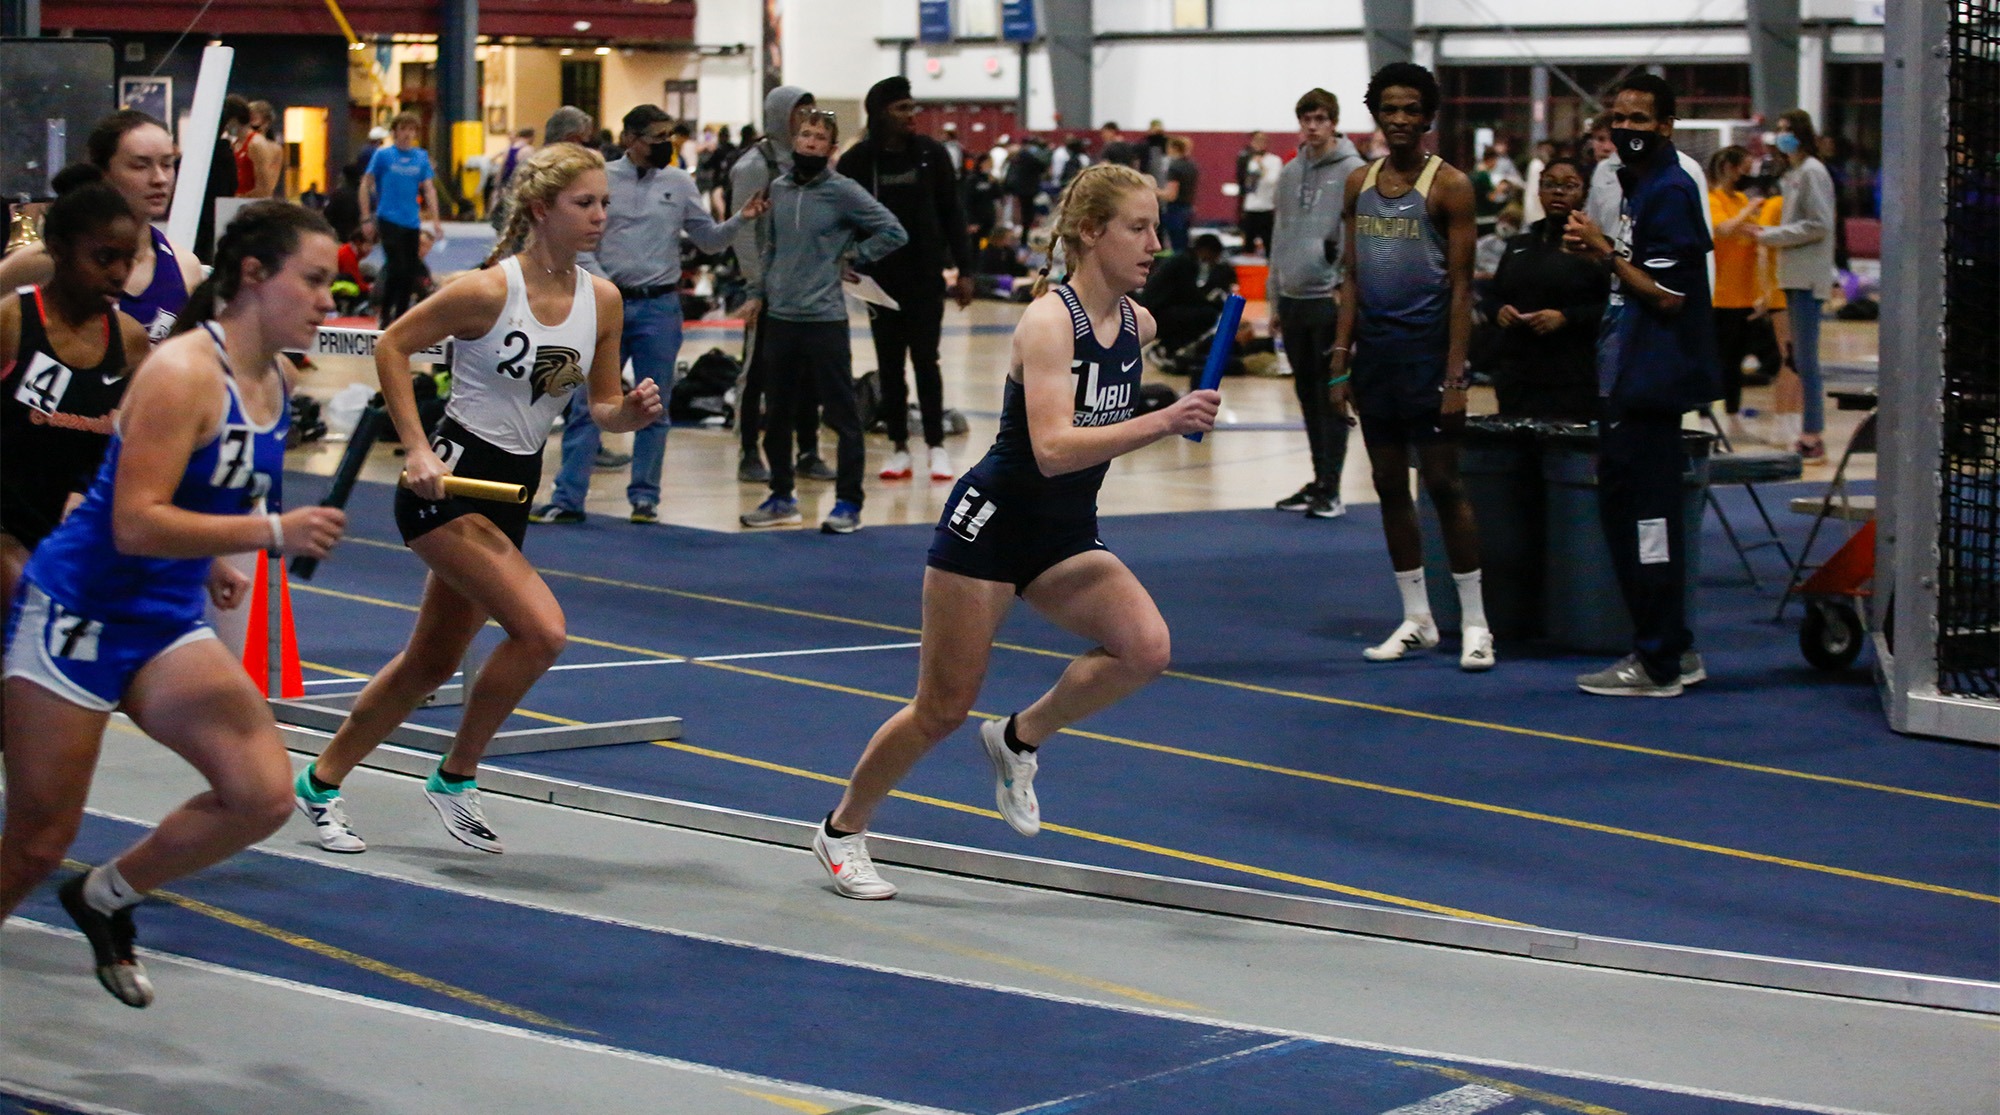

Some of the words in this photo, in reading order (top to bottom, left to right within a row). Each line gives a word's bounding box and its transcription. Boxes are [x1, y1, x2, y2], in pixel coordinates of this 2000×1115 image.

[1356, 214, 1420, 239] PRINCIPIA
[319, 332, 378, 356] PRINCIP
[497, 330, 530, 379] 2
[25, 363, 58, 414] 4
[1072, 408, 1134, 427] SPARTANS
[220, 430, 248, 488] 7
